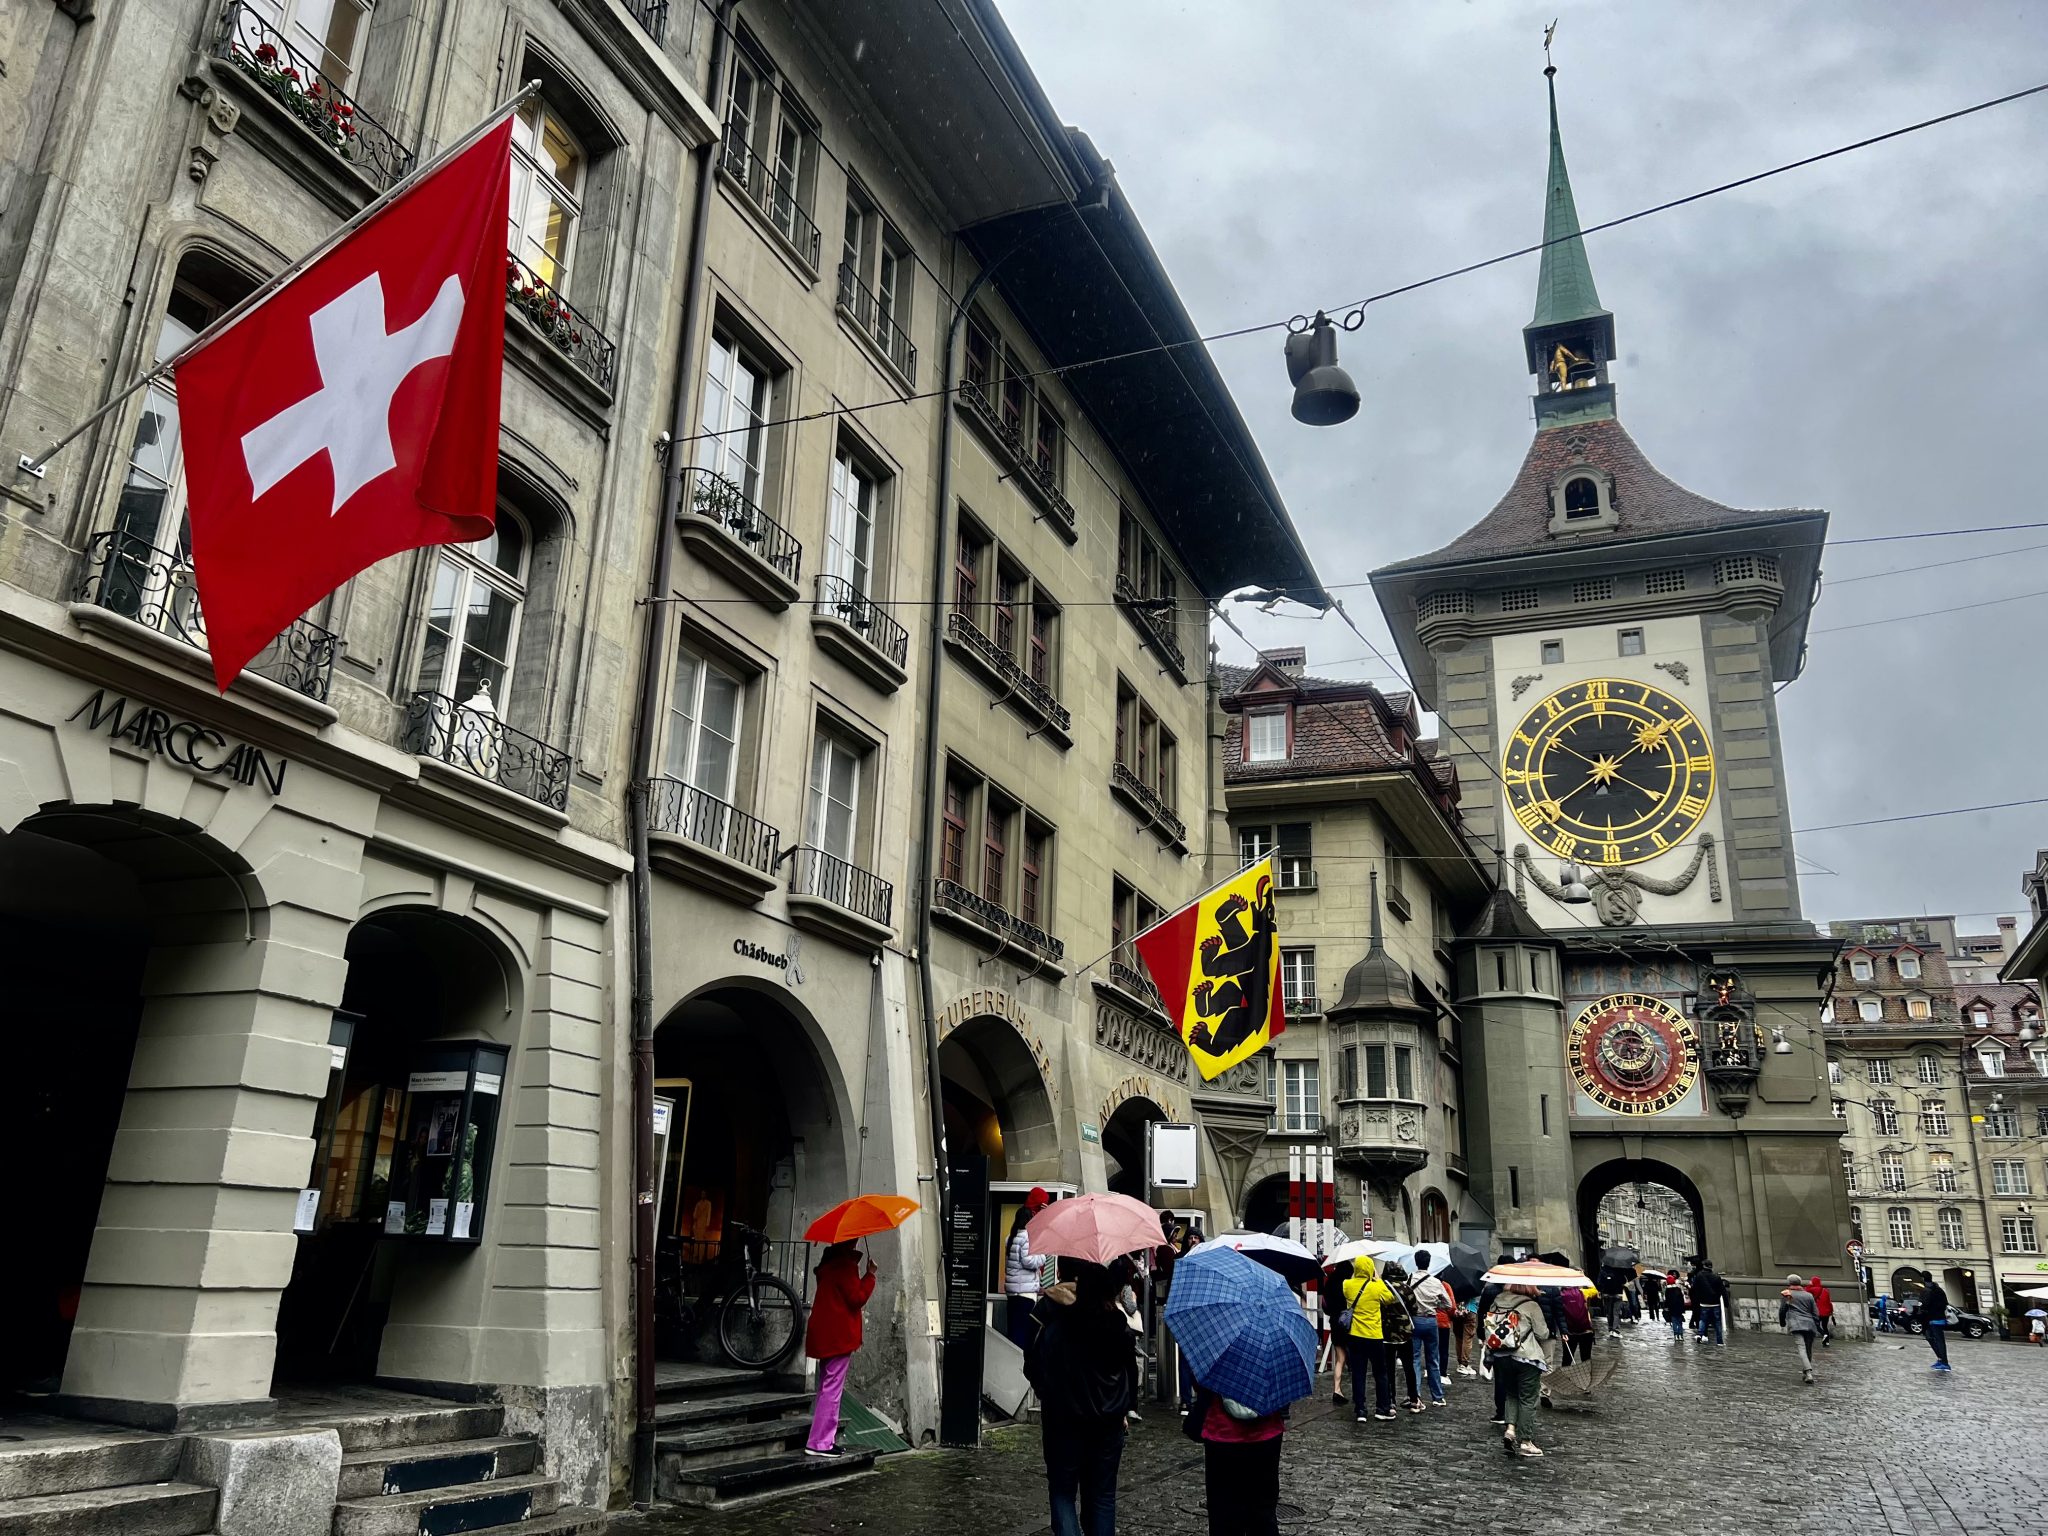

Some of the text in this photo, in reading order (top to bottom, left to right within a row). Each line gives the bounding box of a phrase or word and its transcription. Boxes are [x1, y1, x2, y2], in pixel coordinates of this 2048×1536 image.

[1585, 682, 1610, 700] XII
[1640, 688, 1651, 706] I
[1543, 697, 1565, 719] XI
[1515, 729, 1534, 747] X
[1689, 754, 1711, 772] III
[1506, 767, 1526, 785] IX
[1677, 795, 1706, 819] IIII
[733, 938, 788, 969] Chäsbueb
